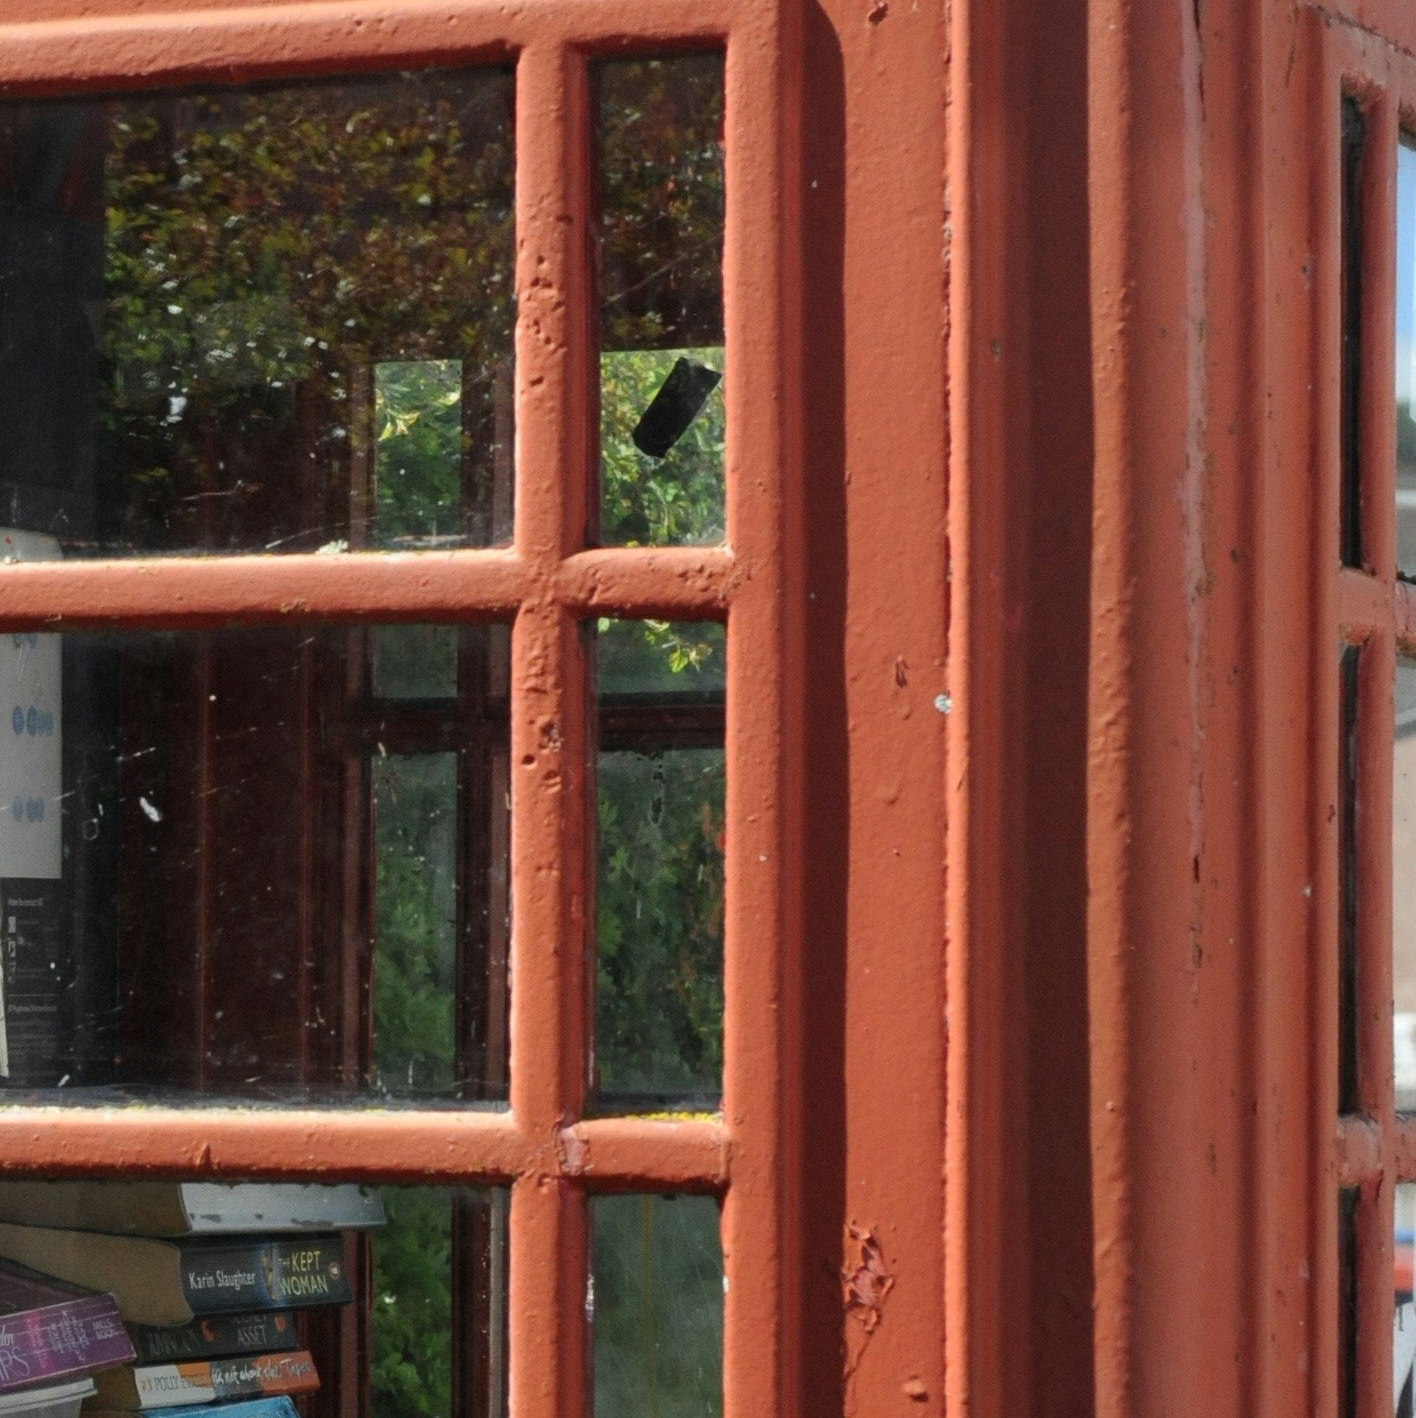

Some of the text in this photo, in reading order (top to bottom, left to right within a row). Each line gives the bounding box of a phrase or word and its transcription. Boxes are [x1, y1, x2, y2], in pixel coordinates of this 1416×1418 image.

[291, 1250, 322, 1272] KEPT
[188, 1270, 256, 1292] Karin Slaughter
[277, 1274, 329, 1296] WOMAN
[236, 1325, 267, 1347] ASSET
